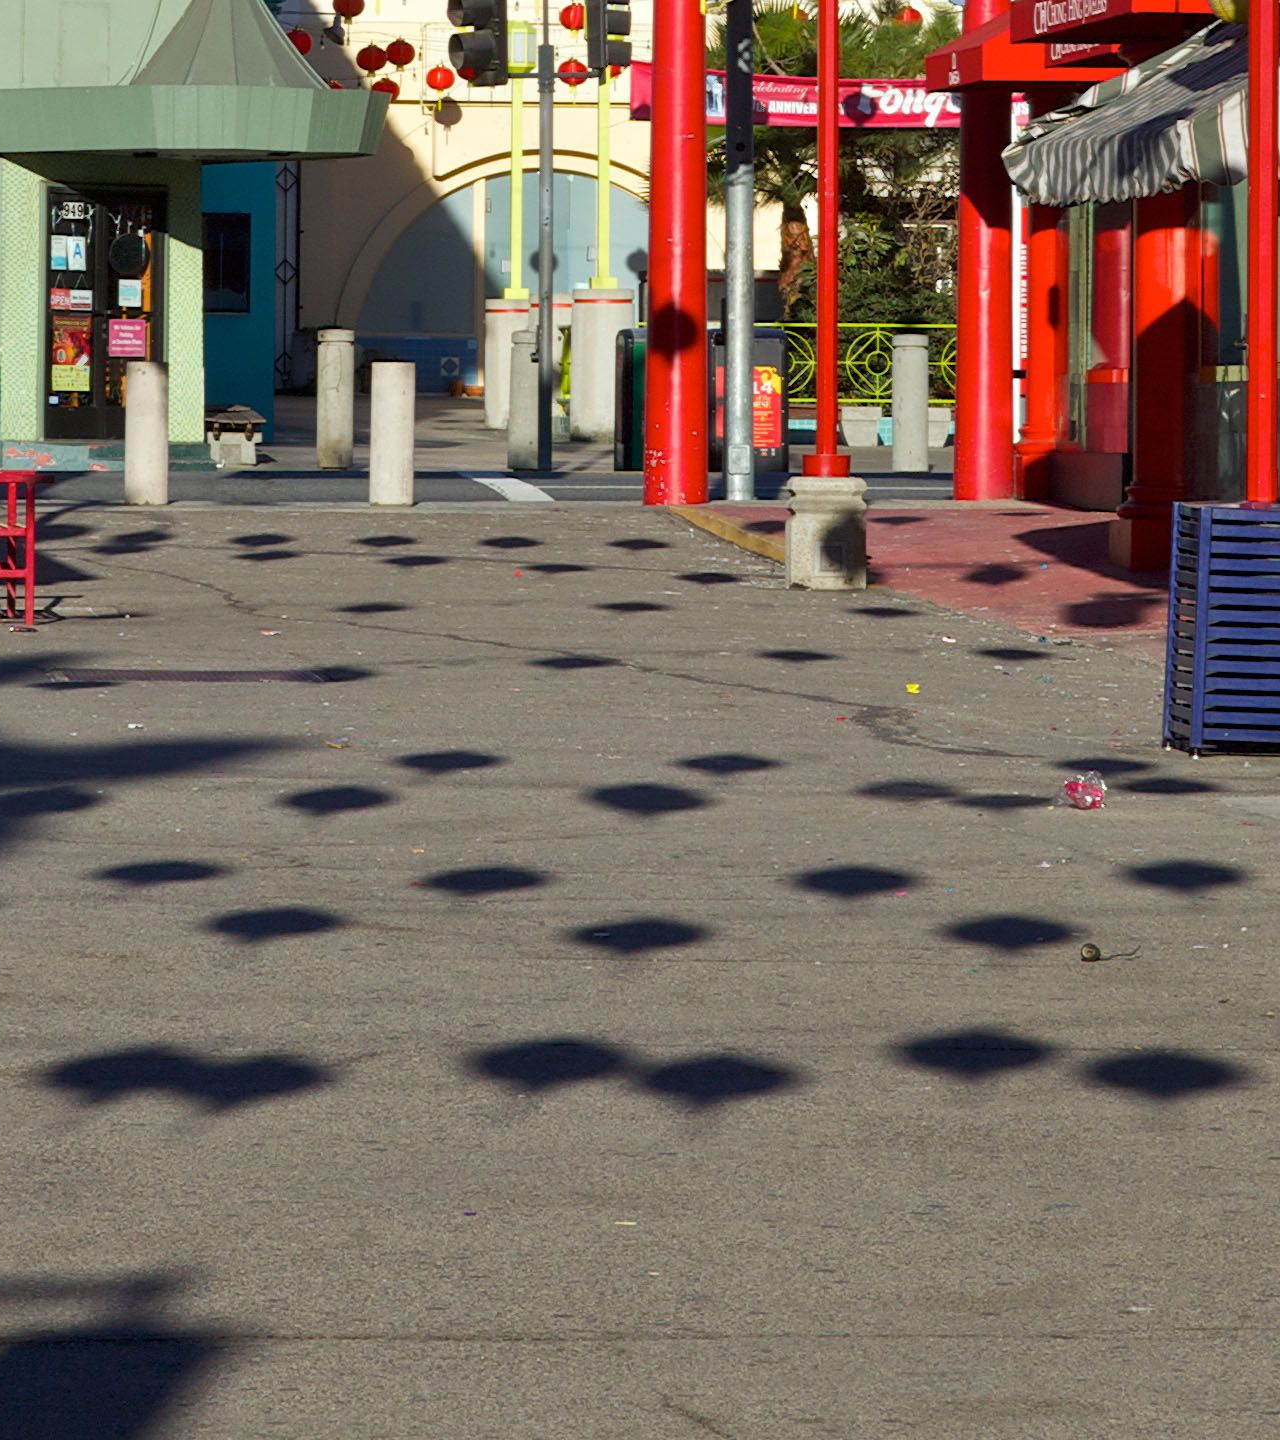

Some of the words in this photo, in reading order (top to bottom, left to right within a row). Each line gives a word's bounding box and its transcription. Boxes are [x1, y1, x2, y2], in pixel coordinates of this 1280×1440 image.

[753, 81, 808, 99] elebrating
[63, 203, 83, 217] 949
[73, 242, 82, 259] A
